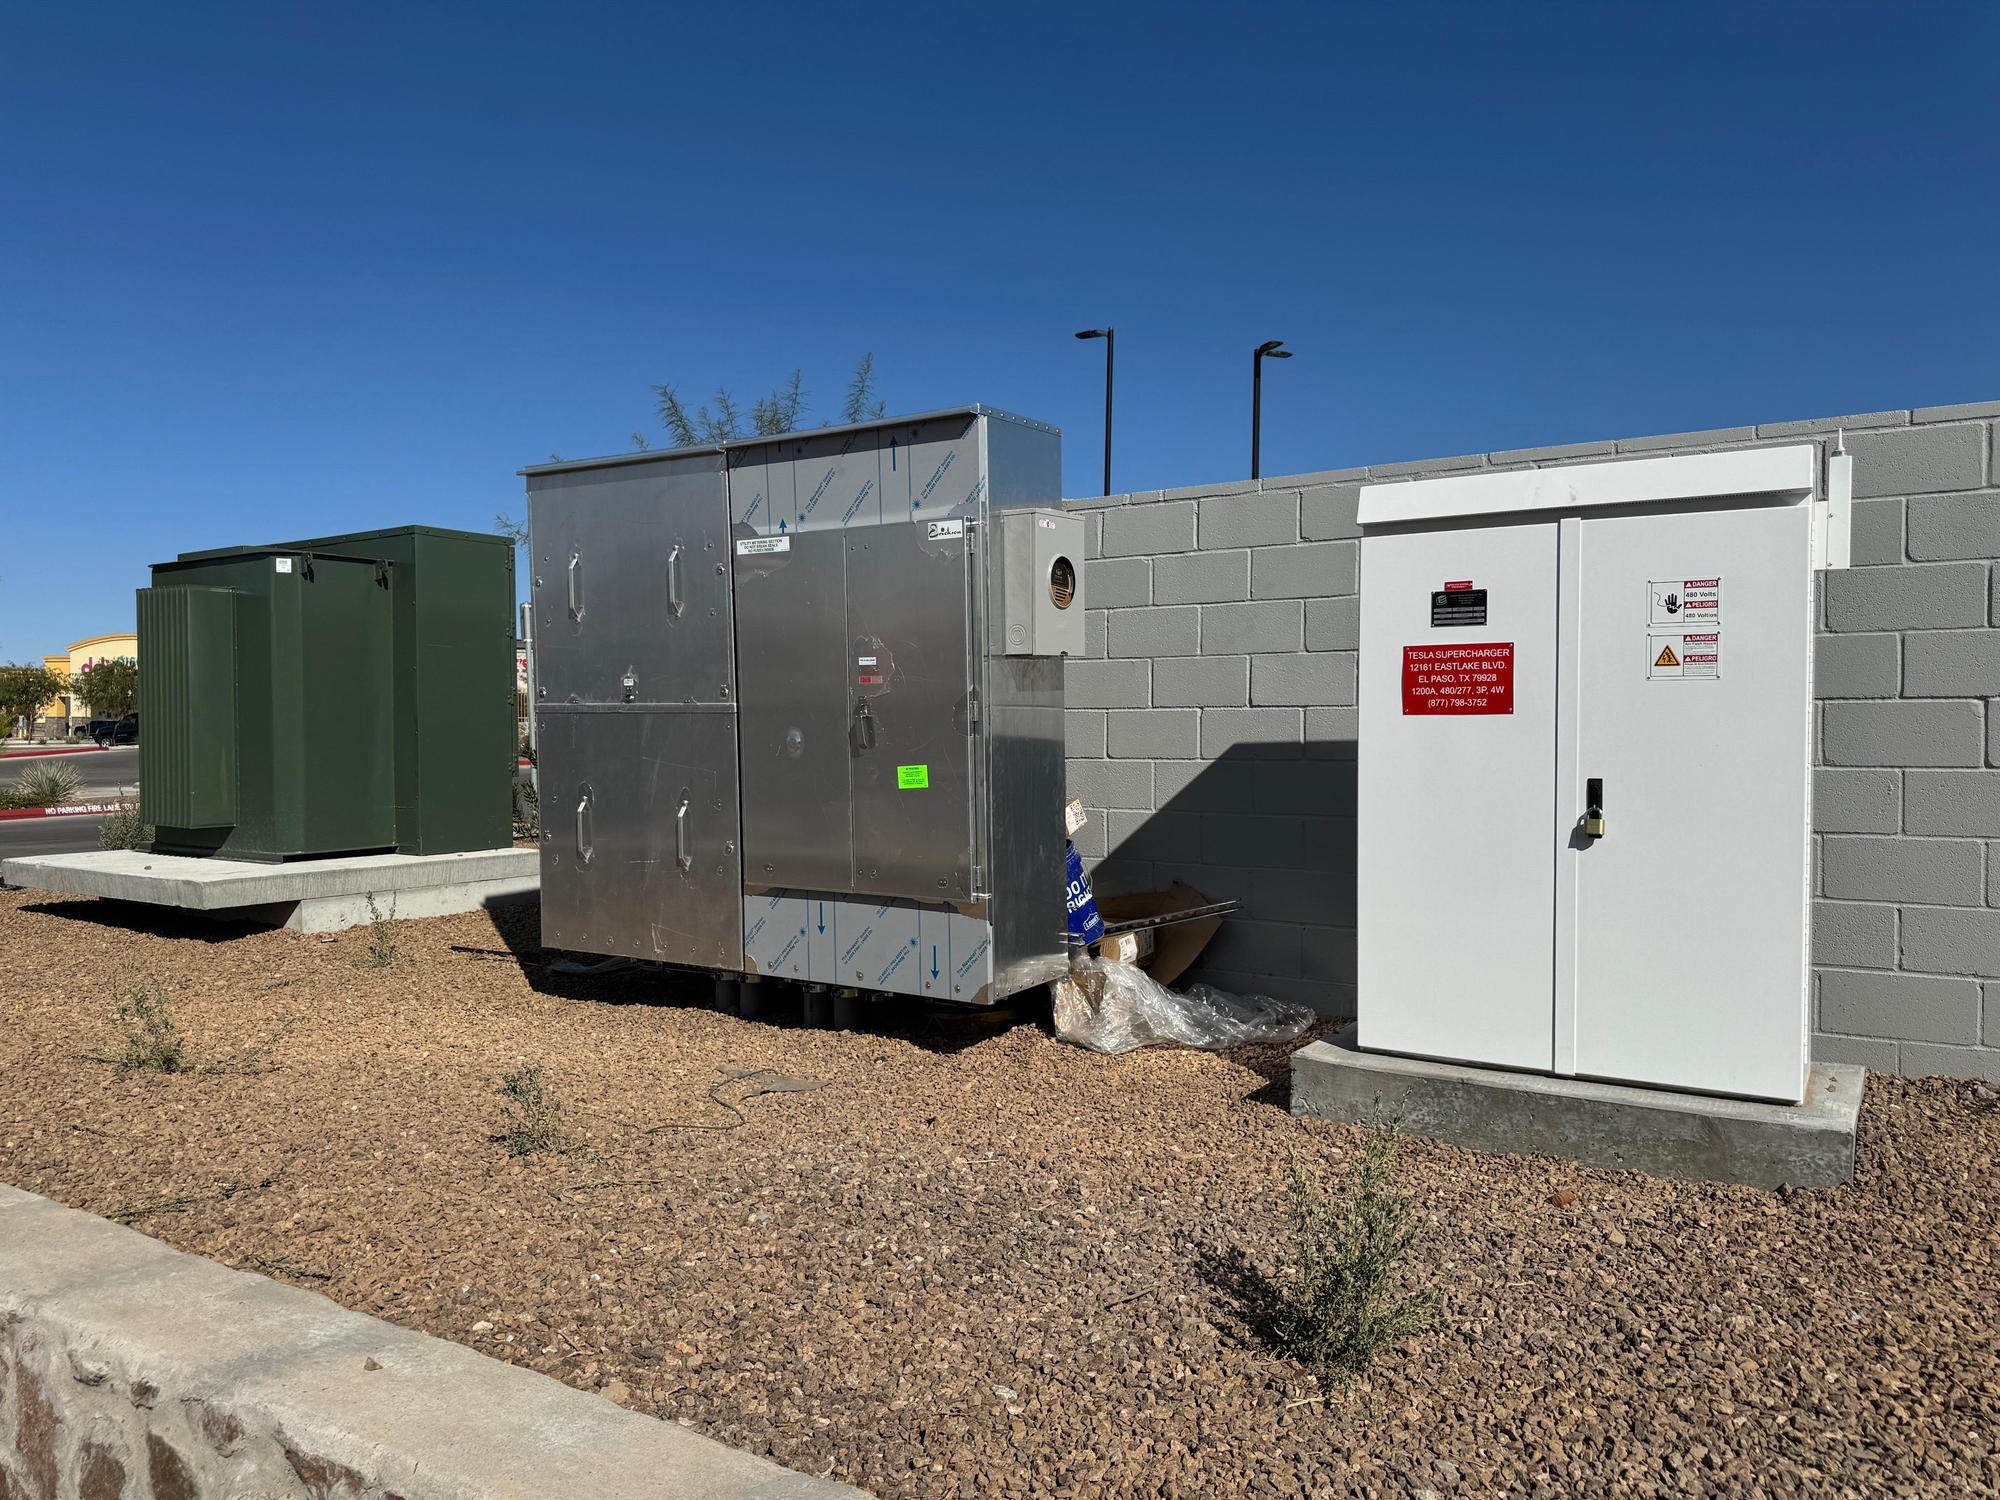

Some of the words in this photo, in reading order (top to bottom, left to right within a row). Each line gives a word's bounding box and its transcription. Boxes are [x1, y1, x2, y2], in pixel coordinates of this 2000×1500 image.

[1436, 649, 1510, 659] SUPERCHARGER
[1435, 662, 1480, 670] EASTLAKE
[1482, 661, 1507, 669] BLVD.
[1431, 674, 1457, 683] PASO,
[1472, 674, 1497, 682] 79928
[1412, 687, 1438, 695] 1200A,
[1440, 686, 1474, 695] 480/277,
[1476, 686, 1488, 694] 3P,
[1428, 699, 1448, 708] (877)
[1450, 699, 1487, 707] 798-3752
[57, 805, 87, 814] PARKING
